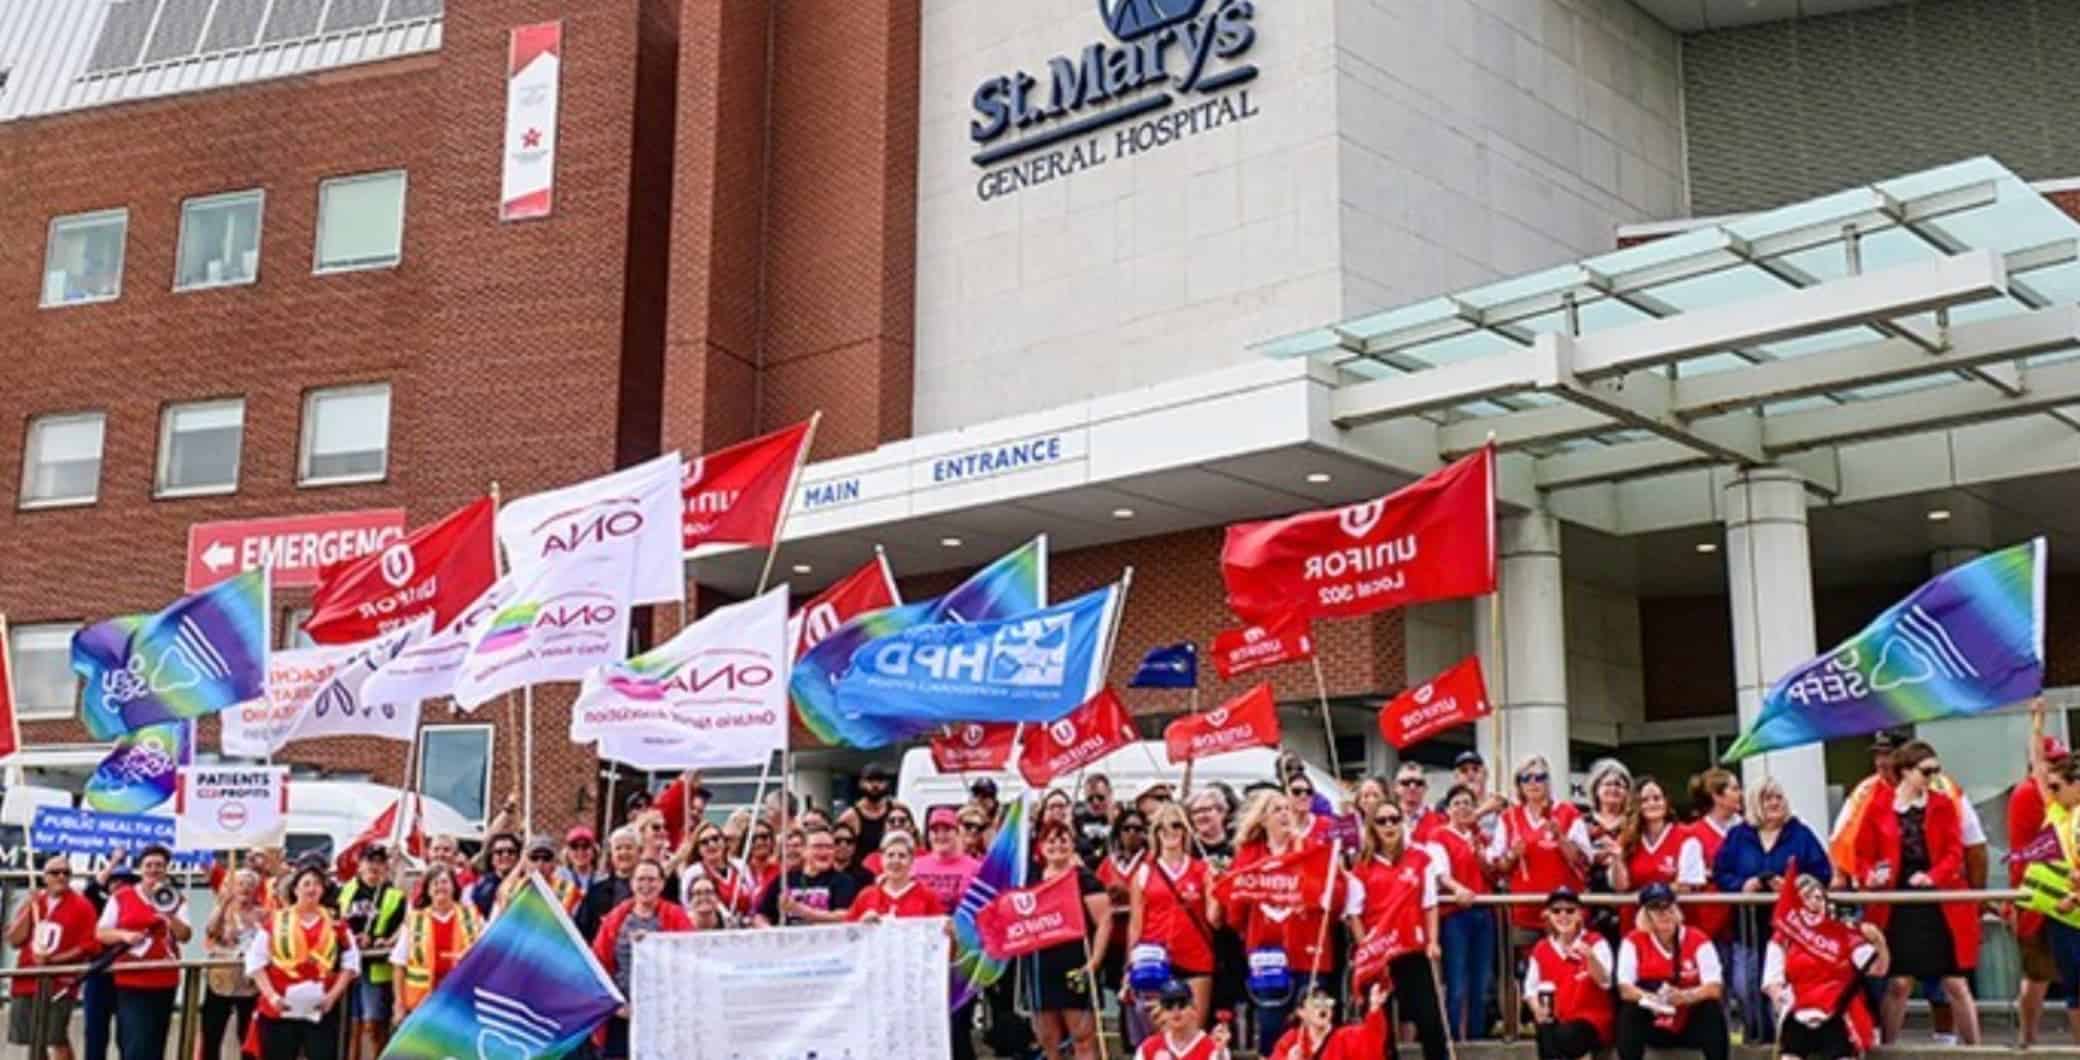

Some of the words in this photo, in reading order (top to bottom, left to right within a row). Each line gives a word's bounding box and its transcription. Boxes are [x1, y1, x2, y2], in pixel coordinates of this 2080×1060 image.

[977, 141, 1106, 202] GENERAL
[1115, 91, 1259, 158] HOSPITAL
[804, 477, 860, 508] MAIN
[932, 437, 1061, 482] ENTRANCE
[196, 772, 271, 786] PATIENTS
[42, 814, 95, 831] PUBLIC
[98, 820, 153, 834] HEALTH
